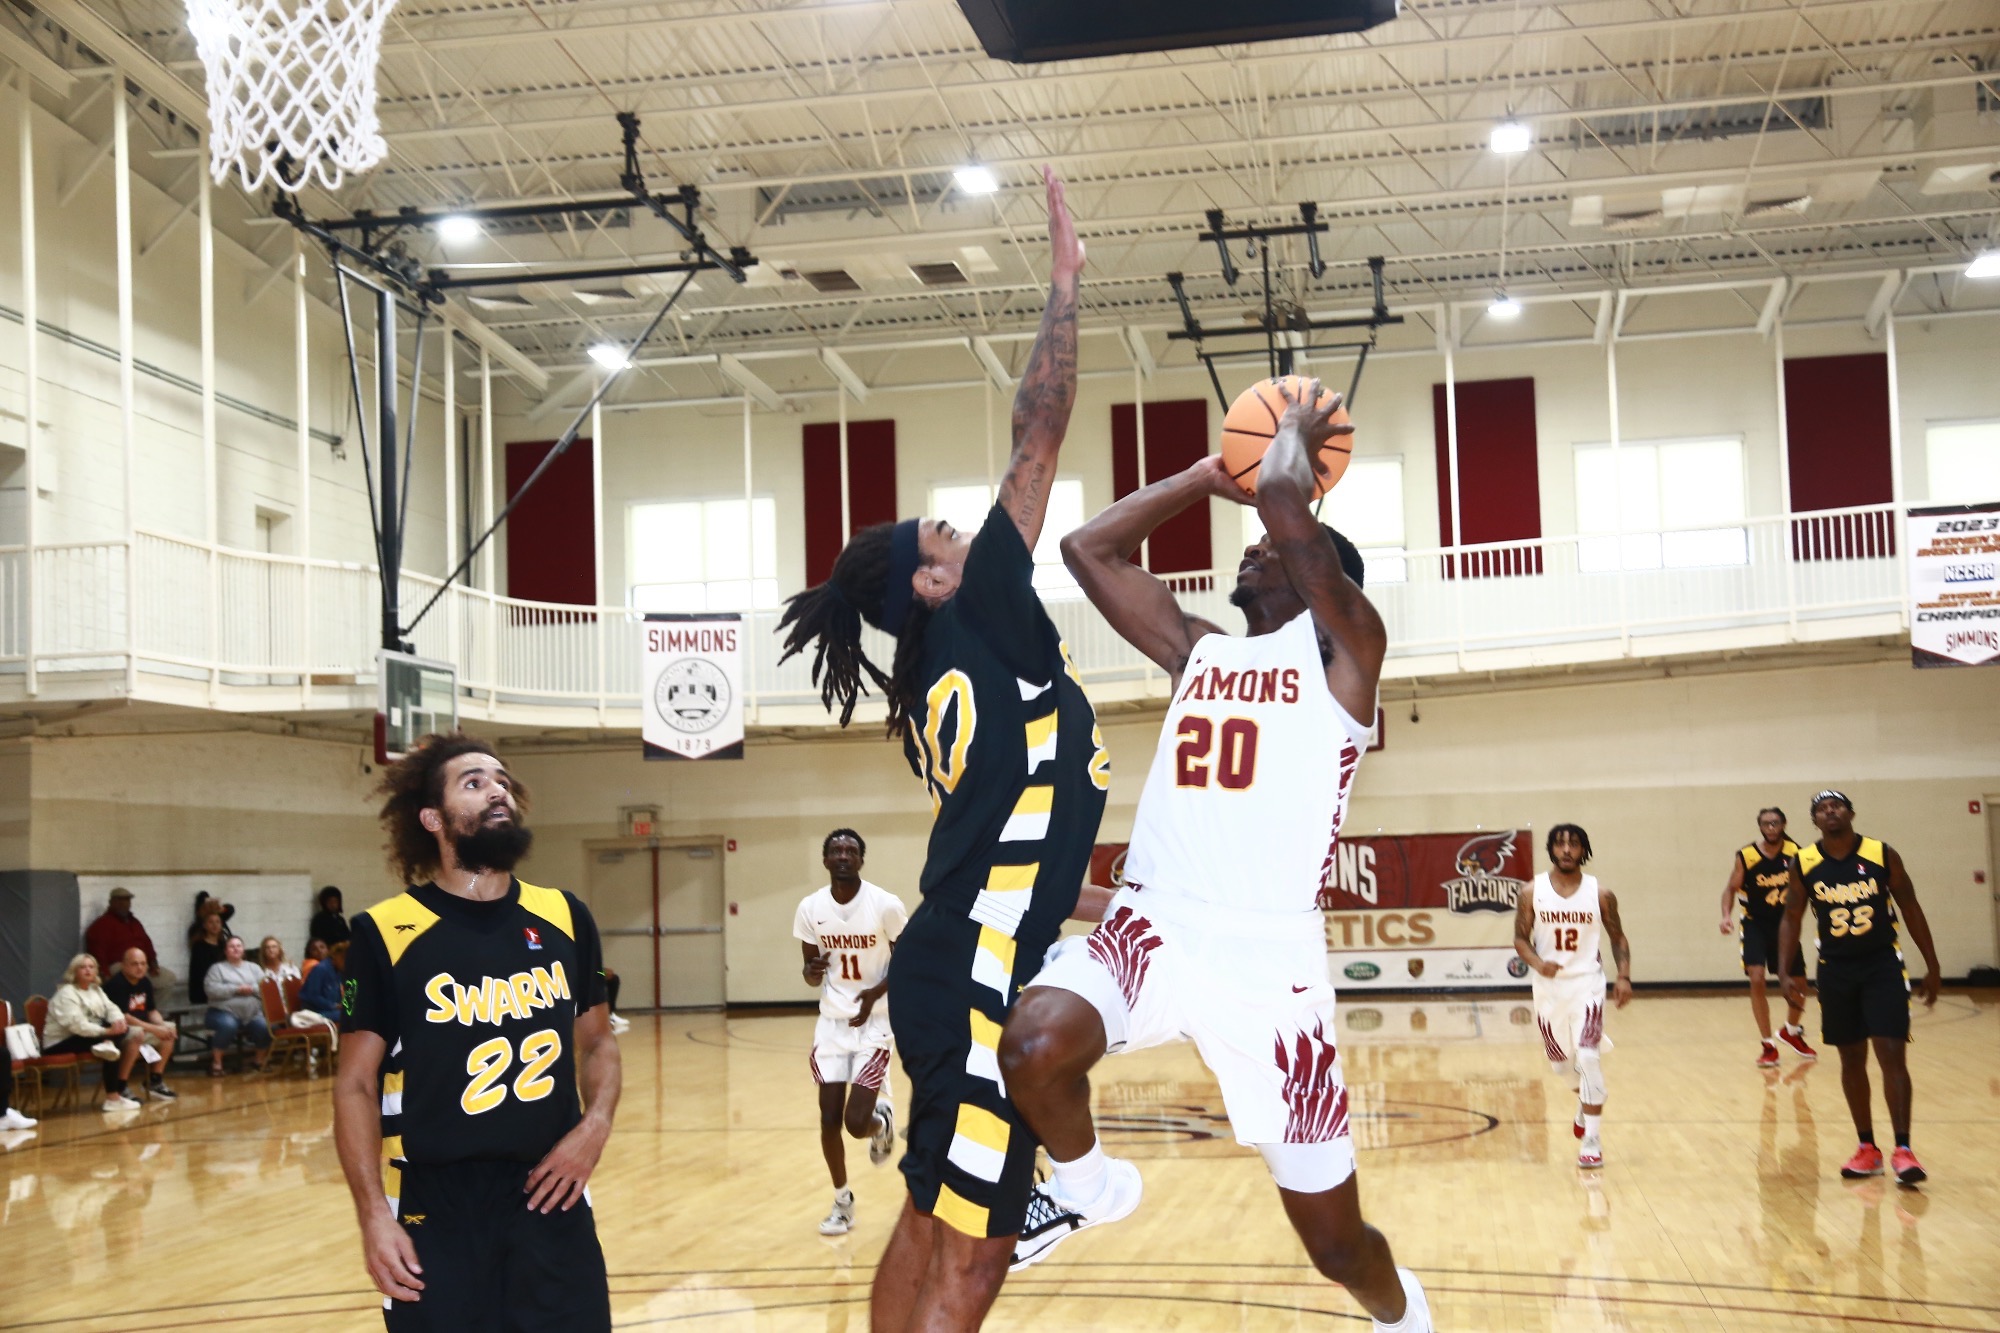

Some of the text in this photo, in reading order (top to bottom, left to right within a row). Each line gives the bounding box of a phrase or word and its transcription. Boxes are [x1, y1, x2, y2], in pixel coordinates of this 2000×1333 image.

[1936, 518, 1999, 533] 2023
[648, 629, 737, 652] SIMMONS
[1946, 629, 1998, 652] SIMMONS
[1176, 714, 1260, 791] 20
[1451, 879, 1518, 911] FALCONS
[1813, 877, 1879, 905] SWARM
[1540, 911, 1594, 924] SIMMONS
[1829, 905, 1874, 938] 33
[820, 934, 876, 949] SIMMONS
[1554, 927, 1579, 952] 12
[840, 953, 862, 980] 11
[425, 960, 571, 1026] SWARM
[460, 1028, 562, 1115] 22
